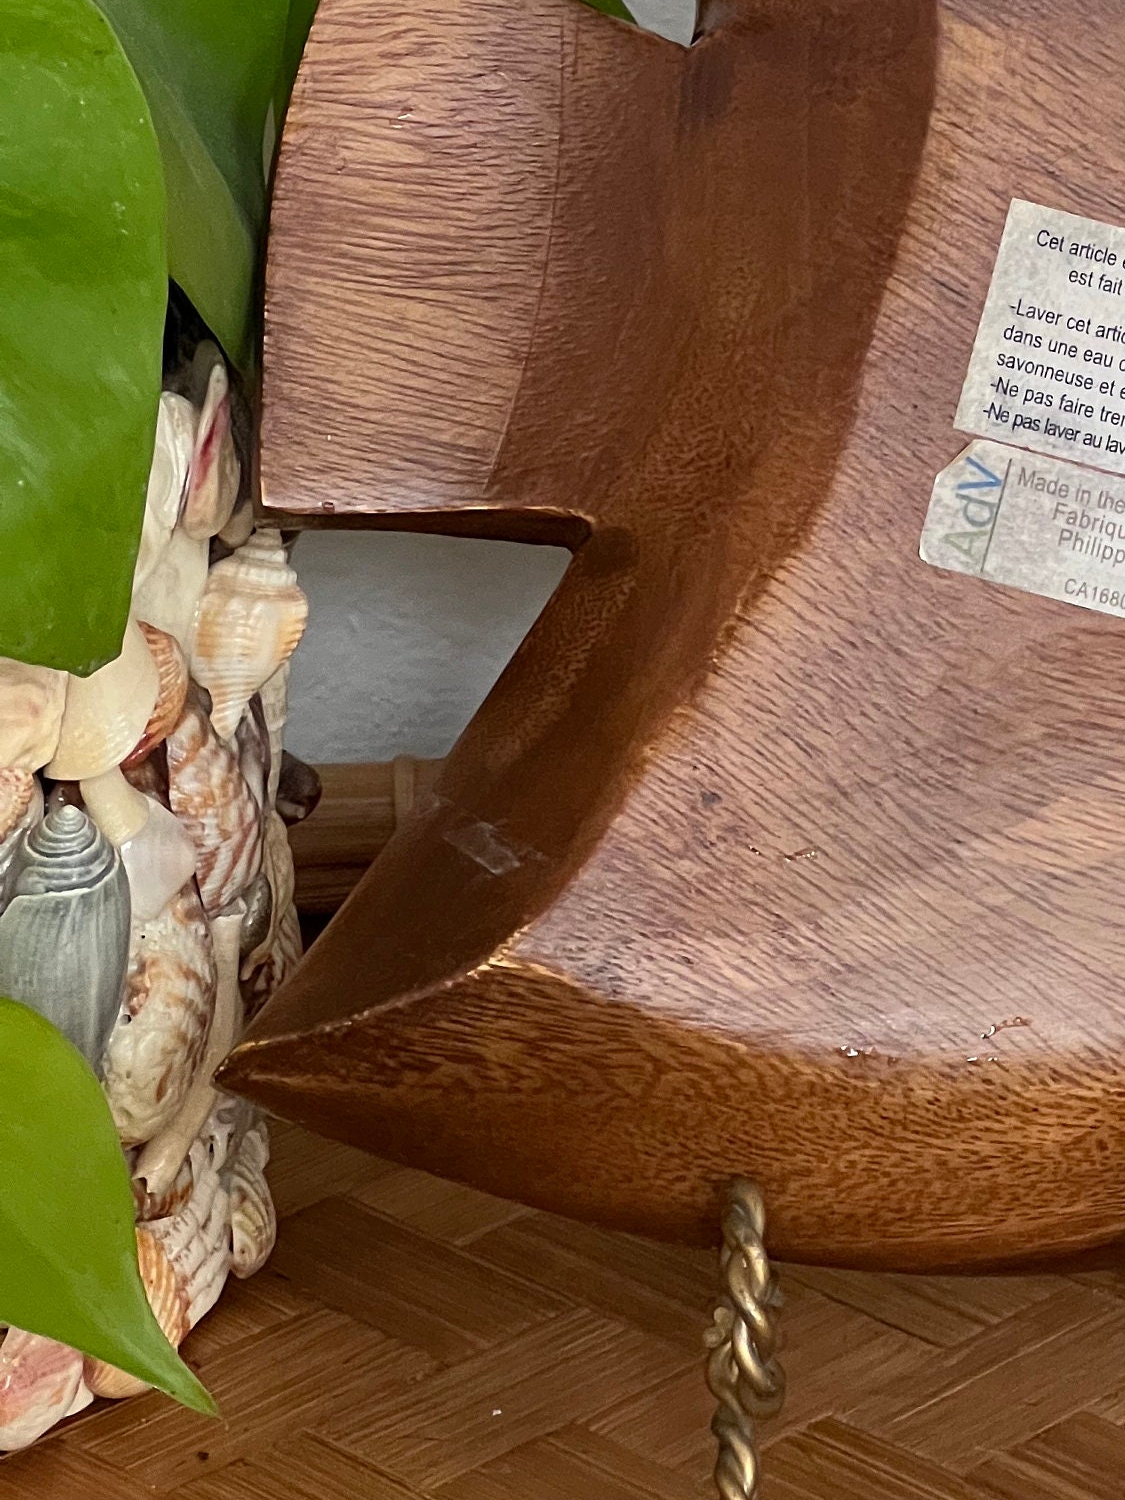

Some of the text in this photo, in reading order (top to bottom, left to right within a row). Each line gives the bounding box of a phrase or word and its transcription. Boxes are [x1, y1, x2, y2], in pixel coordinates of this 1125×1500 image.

[1037, 229, 1064, 252] Cet
[1069, 240, 1117, 267] article
[1068, 267, 1093, 287] est
[1099, 275, 1123, 296] fait
[1009, 298, 1062, 326] -Laver
[1066, 314, 1091, 335] cet
[1003, 325, 1042, 349] dans
[1048, 338, 1078, 358] une
[1083, 349, 1113, 368] eau
[997, 352, 1094, 390] savonneuse
[1099, 380, 1115, 398] et
[990, 377, 1019, 398] -Ne
[1023, 387, 1053, 408] pas
[1060, 392, 1094, 418] faire
[983, 402, 1009, 423] -Ne
[1012, 411, 1041, 432] pas
[1044, 416, 1081, 443] laver
[1083, 432, 1102, 449] au
[1018, 466, 1070, 498] Made
[1076, 483, 1092, 505] in
